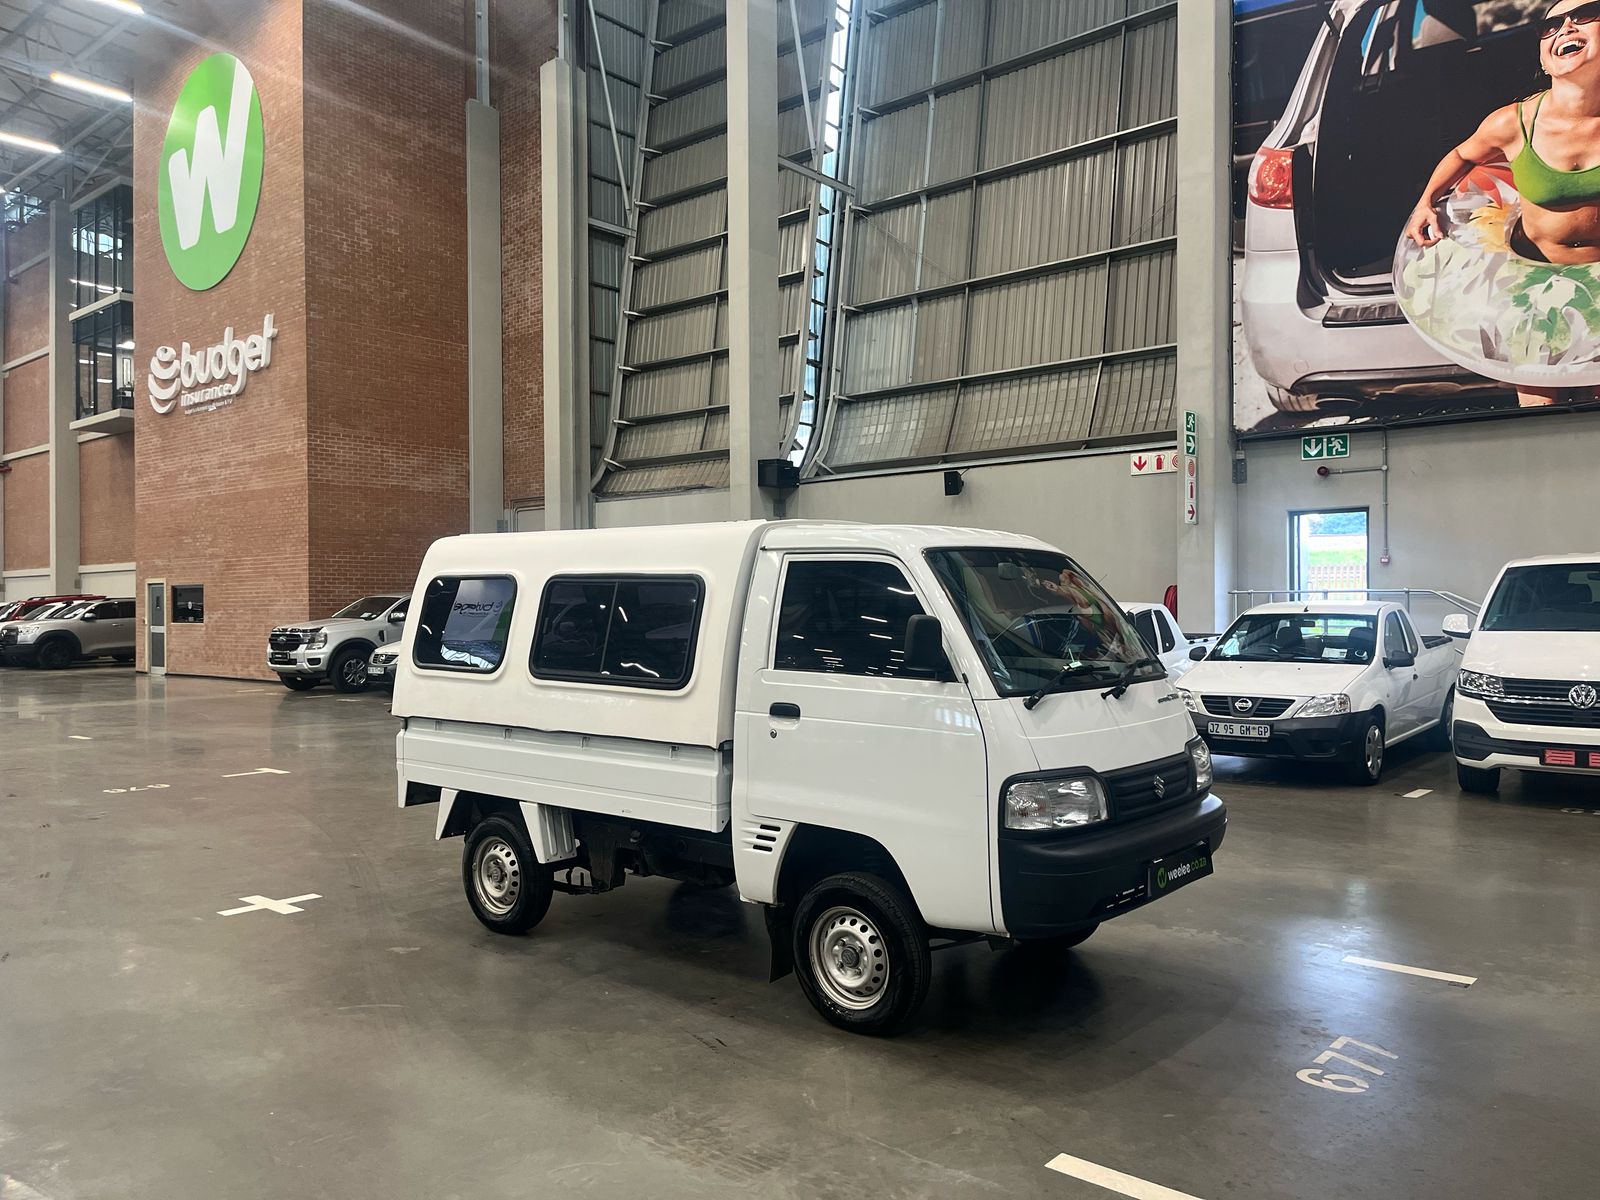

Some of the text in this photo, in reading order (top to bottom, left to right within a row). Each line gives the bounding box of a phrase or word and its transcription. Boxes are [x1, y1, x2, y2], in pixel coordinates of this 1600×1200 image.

[180, 313, 279, 396] budget
[180, 383, 233, 407] insurance
[1209, 723, 1220, 734] JZ
[1223, 724, 1234, 735] 95
[1257, 725, 1269, 737] GP
[1295, 1035, 1399, 1093] 677
